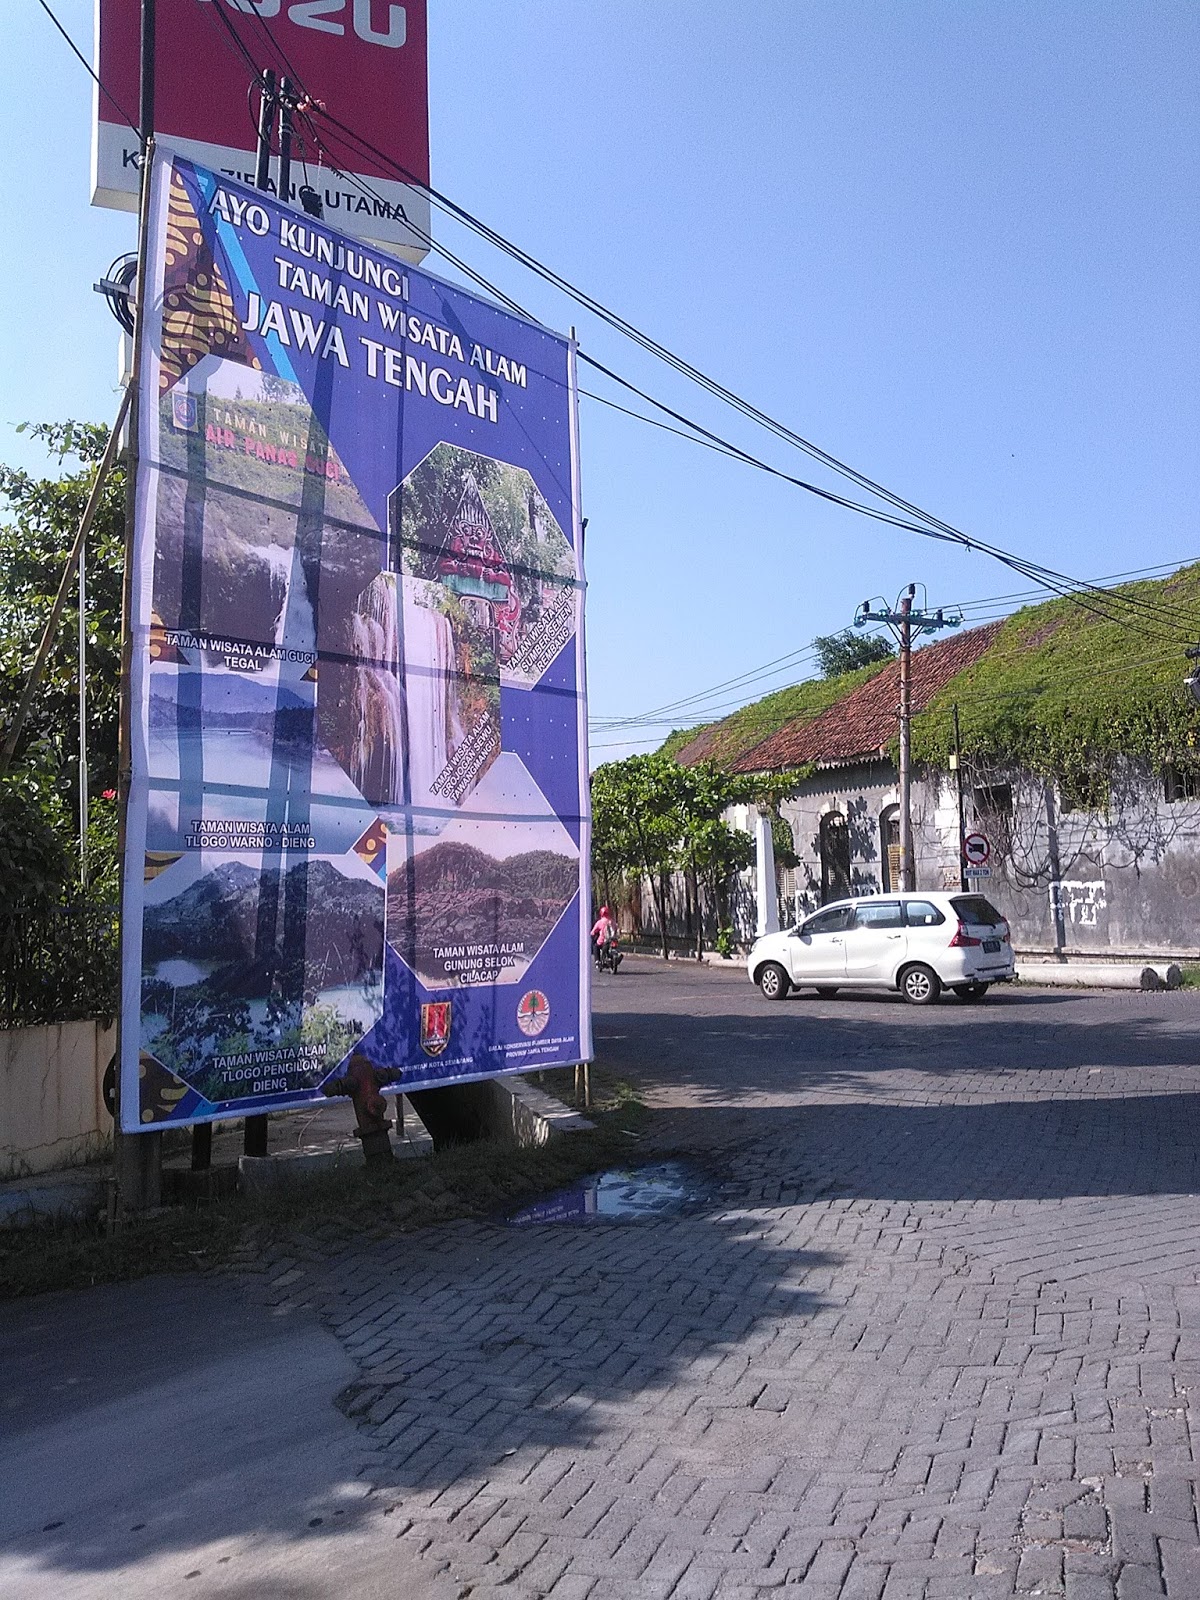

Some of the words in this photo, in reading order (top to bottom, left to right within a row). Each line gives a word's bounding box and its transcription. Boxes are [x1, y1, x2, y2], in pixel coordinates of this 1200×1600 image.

[325, 189, 410, 222] UTAMA
[208, 188, 270, 236] AYO
[280, 218, 410, 301] KUNJUNGI
[274, 257, 369, 322] TAMAN
[377, 302, 465, 362] WISATA
[470, 344, 527, 388] ALAM
[242, 292, 350, 368] JAWA
[360, 337, 498, 424] TENGAH
[206, 423, 236, 449] AIR
[213, 408, 267, 438] TAMAN
[279, 430, 335, 458] WISATA
[507, 638, 532, 670] TAMAN
[529, 608, 556, 641] WISATA
[553, 585, 574, 612] ALAM
[521, 633, 551, 672] SUMBER
[547, 603, 572, 637] SEMEN
[165, 633, 207, 650] TAMAN
[210, 640, 253, 656] WISATA
[254, 647, 285, 660] ALAM
[288, 651, 315, 664] GUCI
[224, 656, 262, 671] TEGAL
[536, 627, 569, 672] REMBANG
[429, 764, 454, 796] TAMAN
[450, 734, 475, 766] WISATA
[472, 711, 490, 737] ALAM
[441, 750, 476, 798] GROJOGAN
[473, 725, 492, 751] SEWU
[450, 738, 496, 801] TAWANGMANGU
[185, 836, 227, 847] TLOGO
[230, 836, 273, 848] WARNO
[282, 838, 315, 848] DIENG
[192, 821, 233, 833] TAMAN
[236, 821, 278, 834] WISATA
[279, 823, 310, 834] ALAM
[433, 946, 465, 958] TAMAN
[467, 944, 499, 956] WISATA
[500, 943, 524, 953] ALAM
[444, 958, 483, 971] GUNUNG
[484, 956, 514, 968] SELOK
[460, 970, 498, 983] CILACAP
[212, 1053, 253, 1069] TAMAN
[254, 1048, 296, 1063] WISATA
[297, 1044, 327, 1058] ALAM
[222, 1066, 261, 1082] TLOGO
[263, 1059, 319, 1076] PENGILON
[253, 1078, 287, 1092] DIENG
